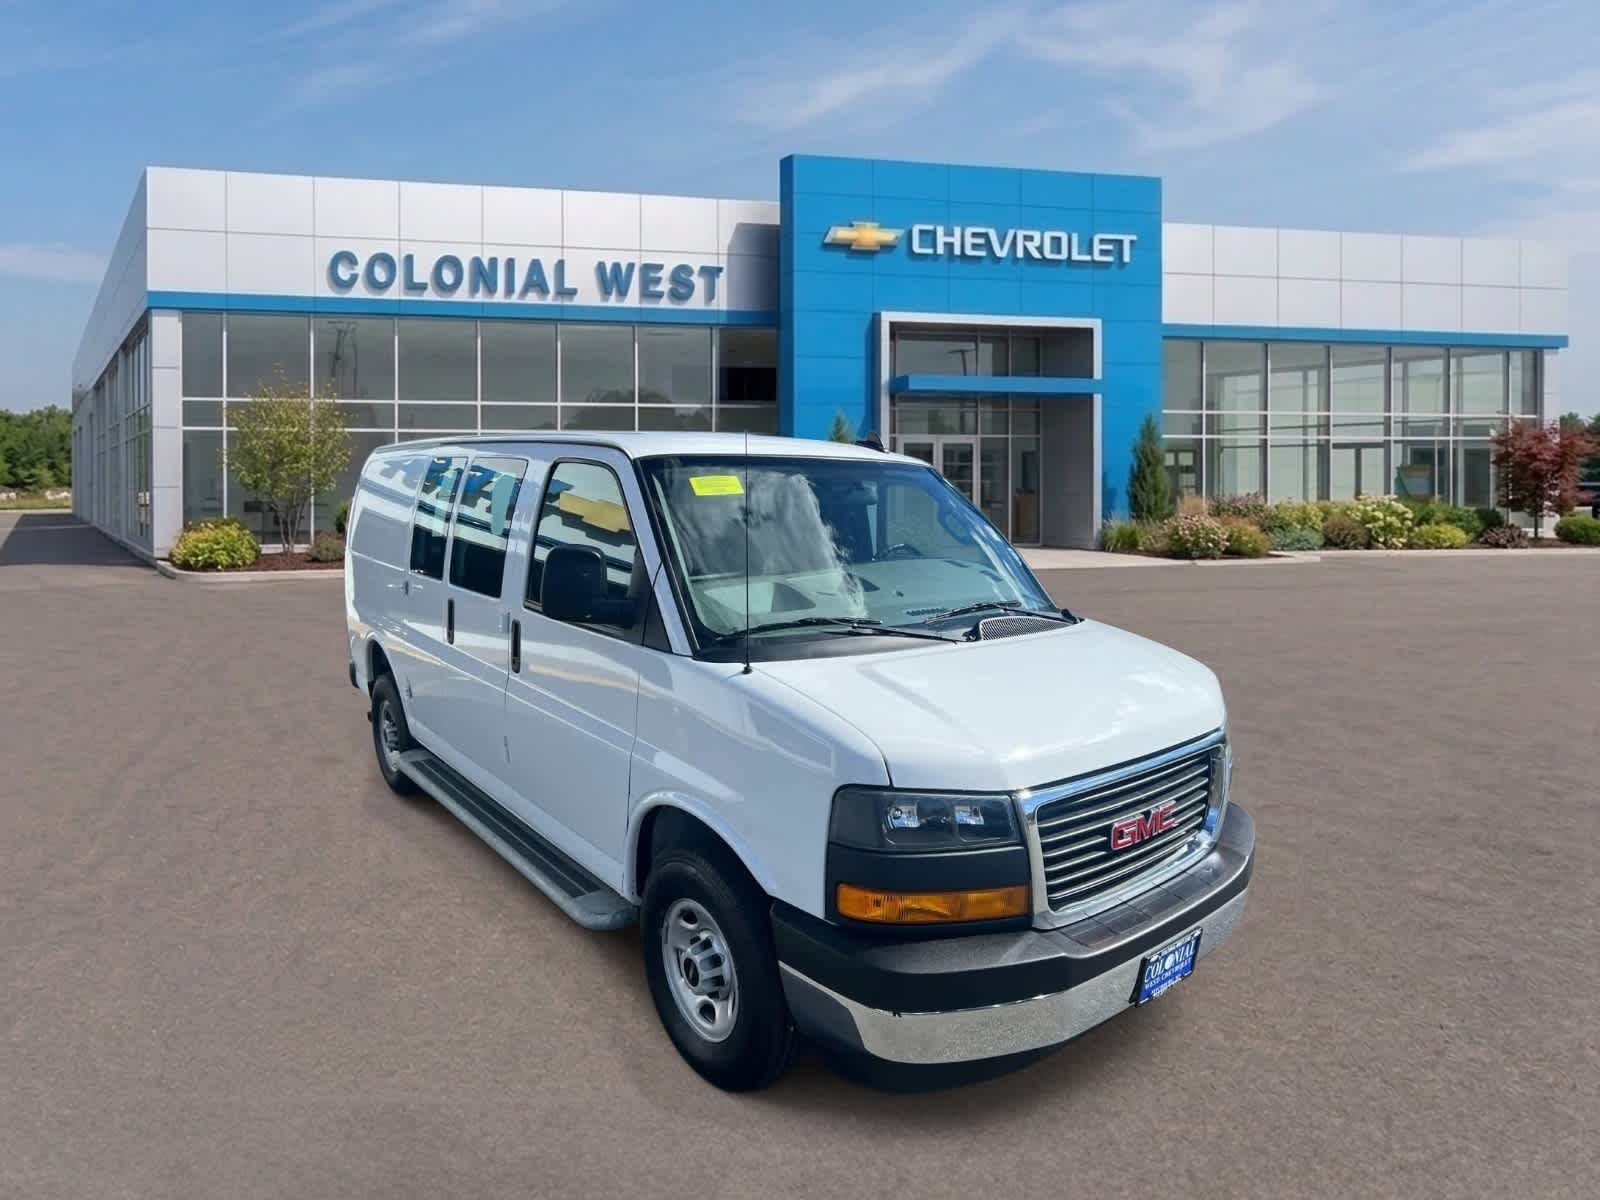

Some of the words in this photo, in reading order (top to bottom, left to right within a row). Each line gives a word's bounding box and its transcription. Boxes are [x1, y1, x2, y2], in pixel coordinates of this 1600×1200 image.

[911, 223, 1137, 262] CHEVROLET
[328, 250, 578, 297] COLONIAL
[595, 260, 723, 303] WEST
[1111, 800, 1178, 850] GMC
